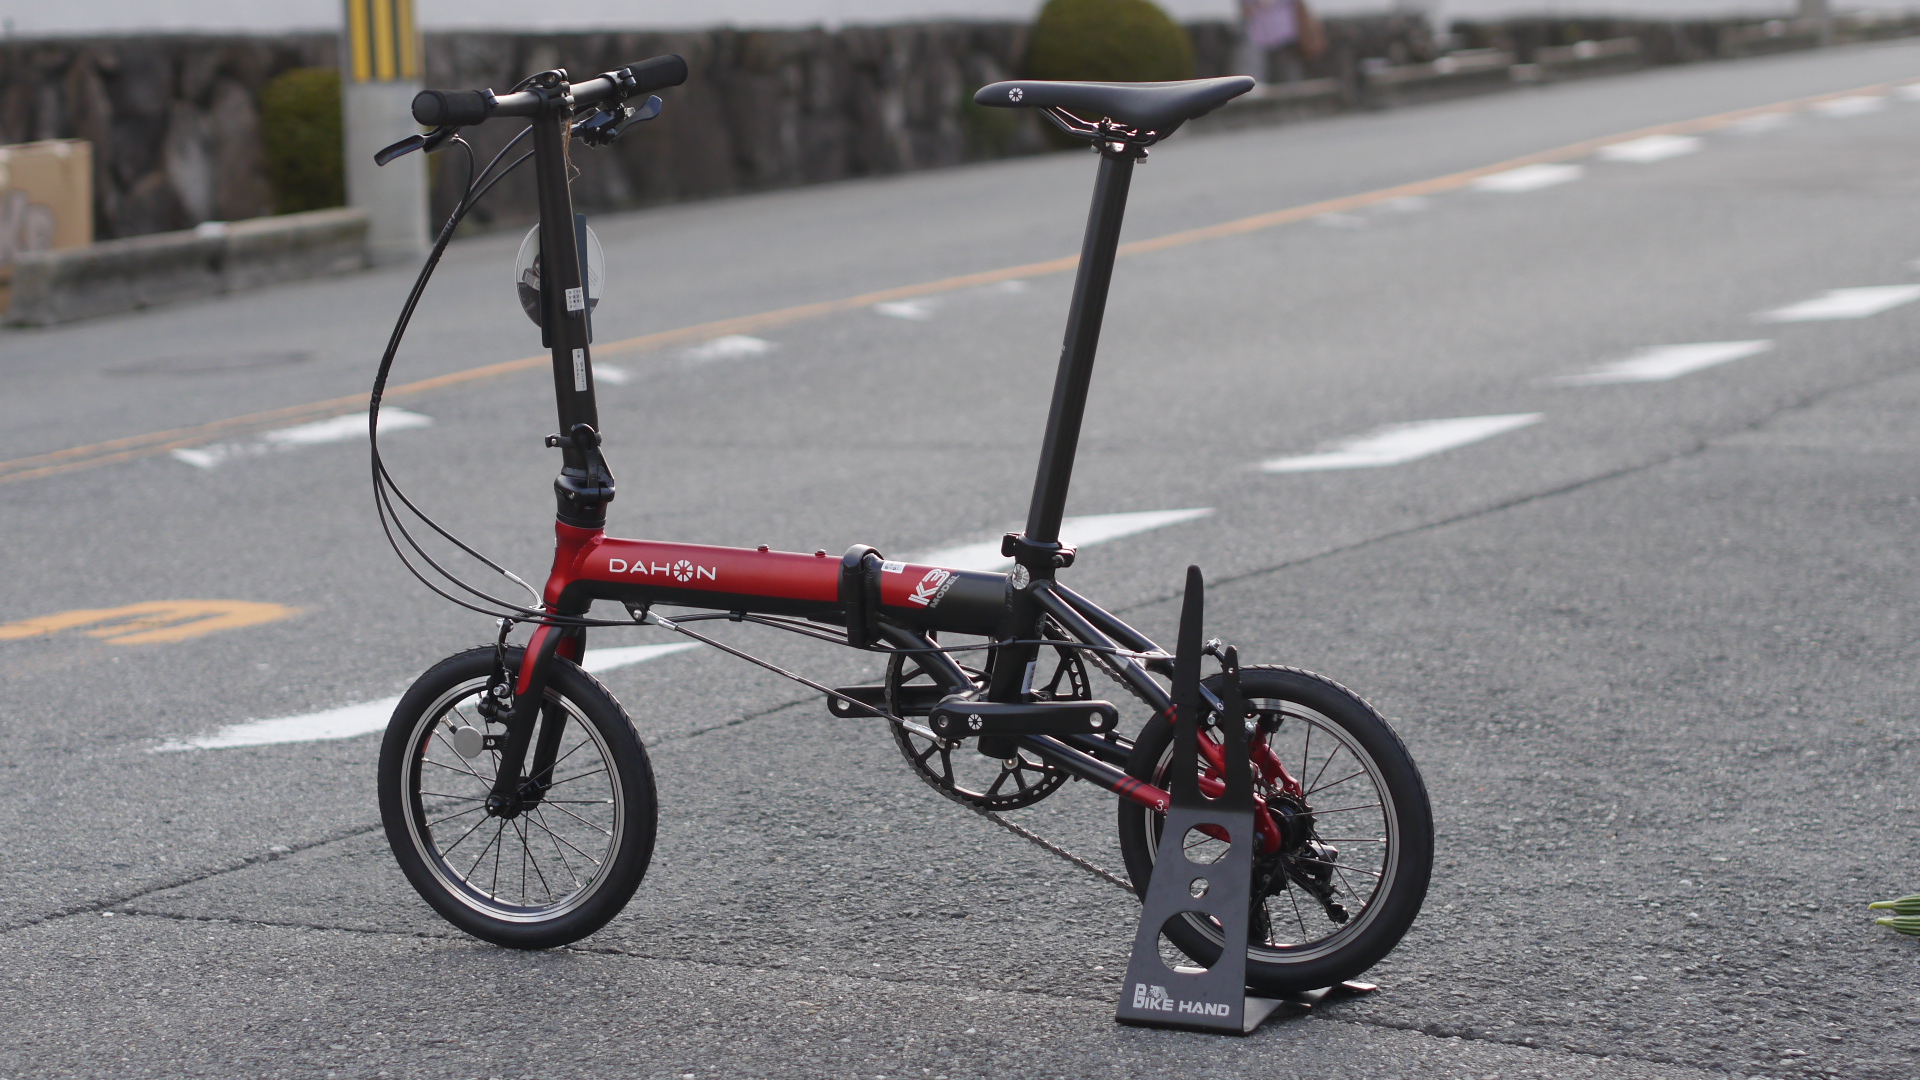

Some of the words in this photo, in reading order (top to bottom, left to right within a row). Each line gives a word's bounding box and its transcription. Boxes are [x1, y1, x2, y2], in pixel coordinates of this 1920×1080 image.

[609, 558, 716, 582] DAHON
[908, 568, 951, 606] K3
[929, 574, 960, 609] MODEL
[1132, 983, 1174, 1011] BIKE
[1178, 1000, 1230, 1017] HAND
